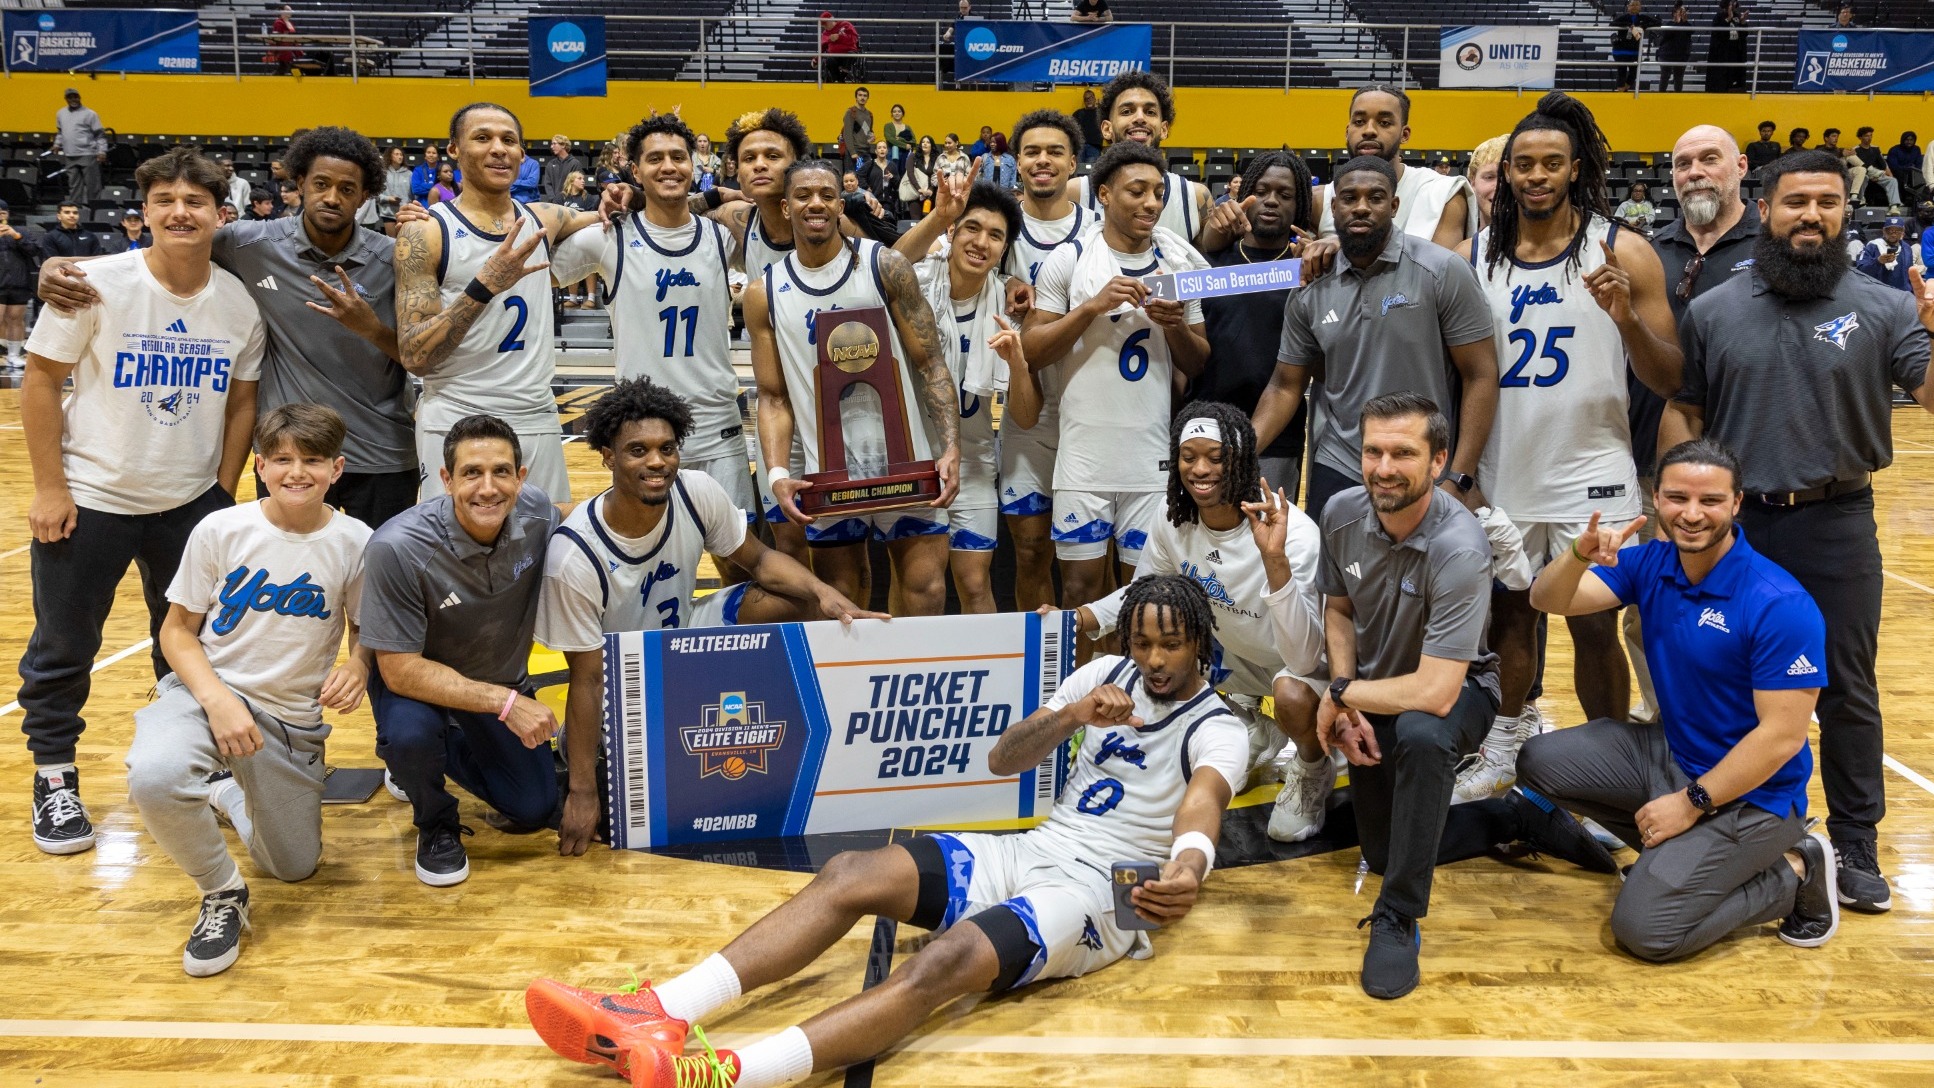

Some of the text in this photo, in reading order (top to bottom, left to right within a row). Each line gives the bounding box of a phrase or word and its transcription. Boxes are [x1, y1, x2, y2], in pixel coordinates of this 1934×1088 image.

[39, 37, 97, 49] BASKETBALL
[552, 41, 585, 53] NCAA
[967, 42, 1024, 53] NCAA.com
[1489, 44, 1542, 60] UNITED
[158, 57, 197, 69] #D2MBB
[1827, 68, 1876, 77] CHAMPIONSHIP
[1829, 58, 1887, 69] BASKETBALL
[656, 267, 700, 302] Yotes
[1156, 267, 1293, 297] 2 CSU San Bernardino
[1511, 281, 1564, 324] Yotes
[497, 296, 528, 353] 2
[659, 306, 699, 357] 11
[141, 340, 212, 355] REGULAR SEASON
[833, 342, 878, 362] NCAA
[1119, 328, 1151, 382] 6
[1499, 326, 1576, 388] 25
[113, 352, 231, 393] CHAMPS
[141, 391, 200, 404] 20 24
[832, 483, 913, 502] REGIONAL CHAMPION
[1205, 555, 1223, 565] adidas
[212, 565, 331, 636] Yotes
[1210, 600, 1262, 619] KETBALL
[1698, 607, 1726, 627] Yotes
[670, 632, 770, 654] #ELITEEIGHT
[1787, 665, 1818, 676] adidas
[869, 670, 990, 708] TICKET
[844, 703, 1012, 745] PUNCHED
[693, 729, 776, 748] ELITE EIGHT
[877, 743, 971, 778] 2024
[1076, 778, 1125, 816] 0
[692, 814, 758, 832] #D2MBB
